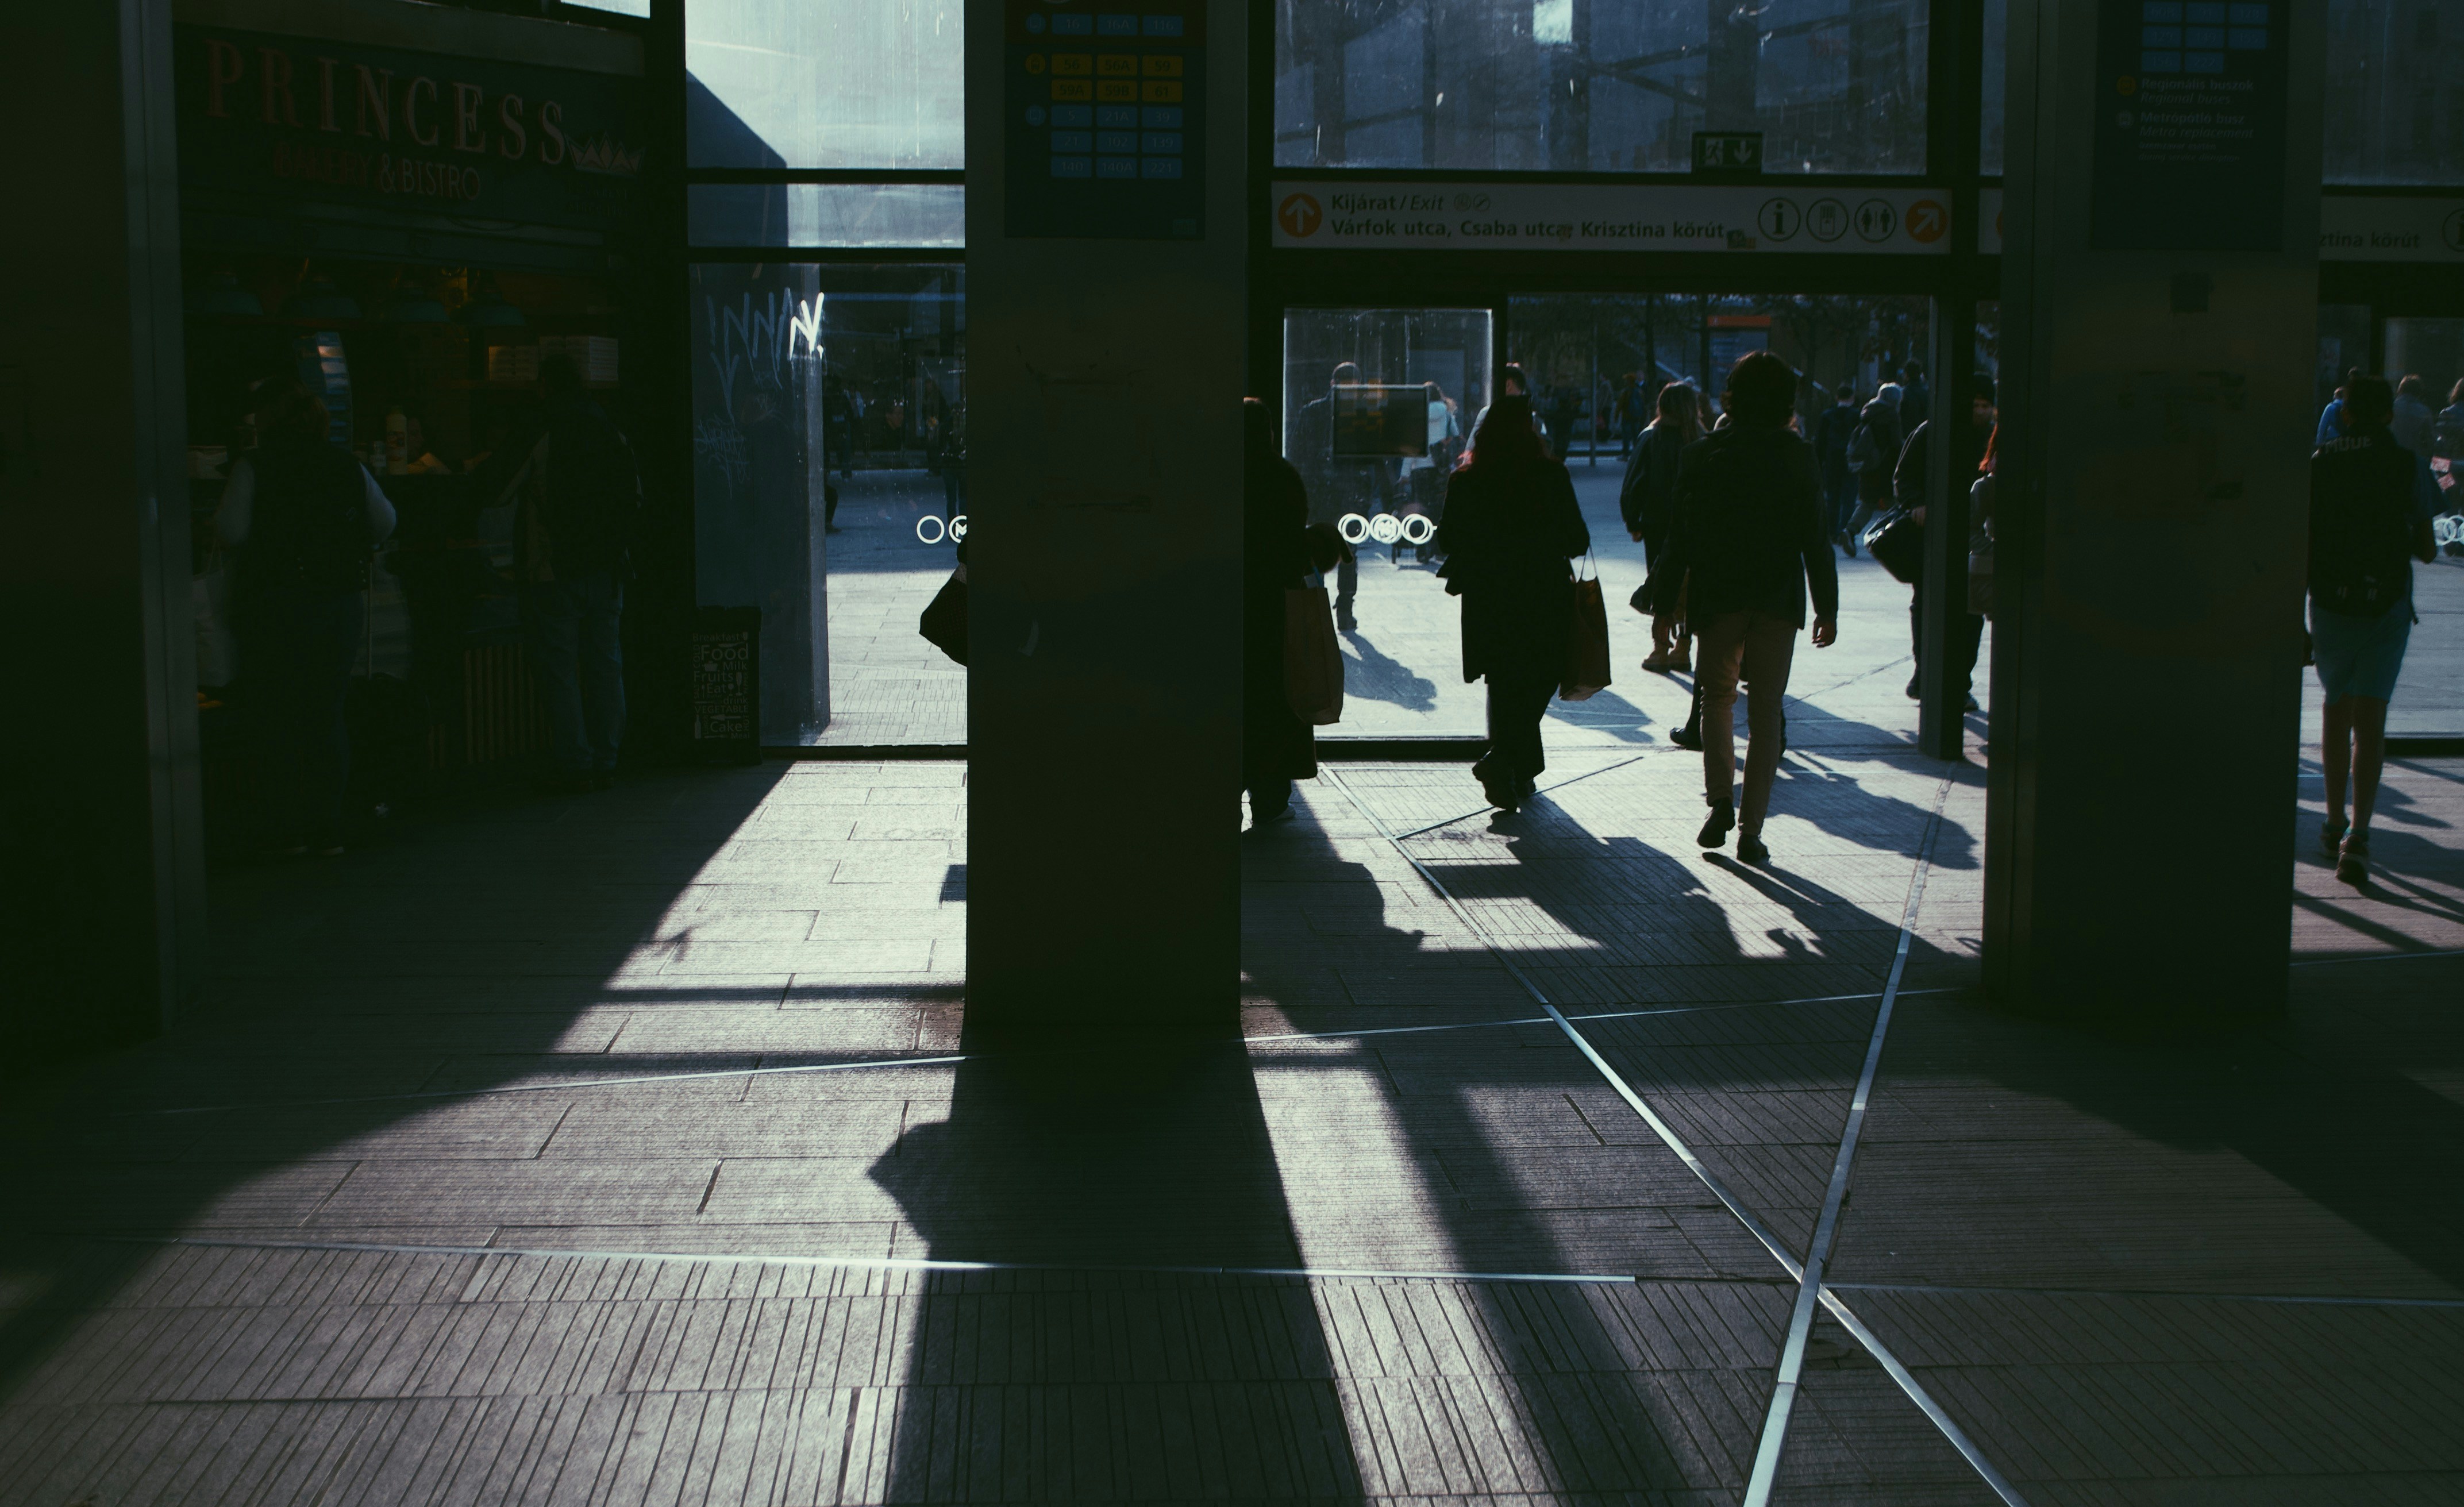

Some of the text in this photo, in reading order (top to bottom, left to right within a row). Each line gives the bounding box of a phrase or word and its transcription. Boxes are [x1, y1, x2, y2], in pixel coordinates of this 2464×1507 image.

[1065, 18, 1174, 31] 16 16A 116
[1063, 59, 1171, 72] 56 56A 59
[1059, 84, 1169, 98] 59A 59B 61
[2141, 78, 2254, 92] Regionális buszok
[203, 38, 565, 165] PRINCESS
[2140, 92, 2231, 106] Regional buses
[1068, 110, 1171, 123] 5 21A 39
[2140, 111, 2246, 126] Metrópótló busz
[2139, 125, 2254, 141] Metro replacement
[1064, 136, 1174, 148] 21 102 139
[274, 142, 481, 202] BAKERY & BISTRO
[1061, 161, 1172, 174] 140 140A 221
[1332, 194, 1396, 214] Kijárat
[1411, 195, 1443, 211] Exit
[1332, 219, 1396, 236] Várfok
[1404, 222, 1452, 238] utca,
[1461, 221, 1518, 237] Csaba
[1581, 221, 1665, 238] Krisztina
[692, 633, 740, 642] Breakfast
[701, 643, 749, 661] Food
[723, 661, 748, 670] Milk
[694, 670, 734, 683] Fruits
[707, 683, 726, 694] Eat
[723, 696, 748, 705] drink
[694, 706, 749, 714] VEGETABLE
[710, 720, 743, 733] Cake
